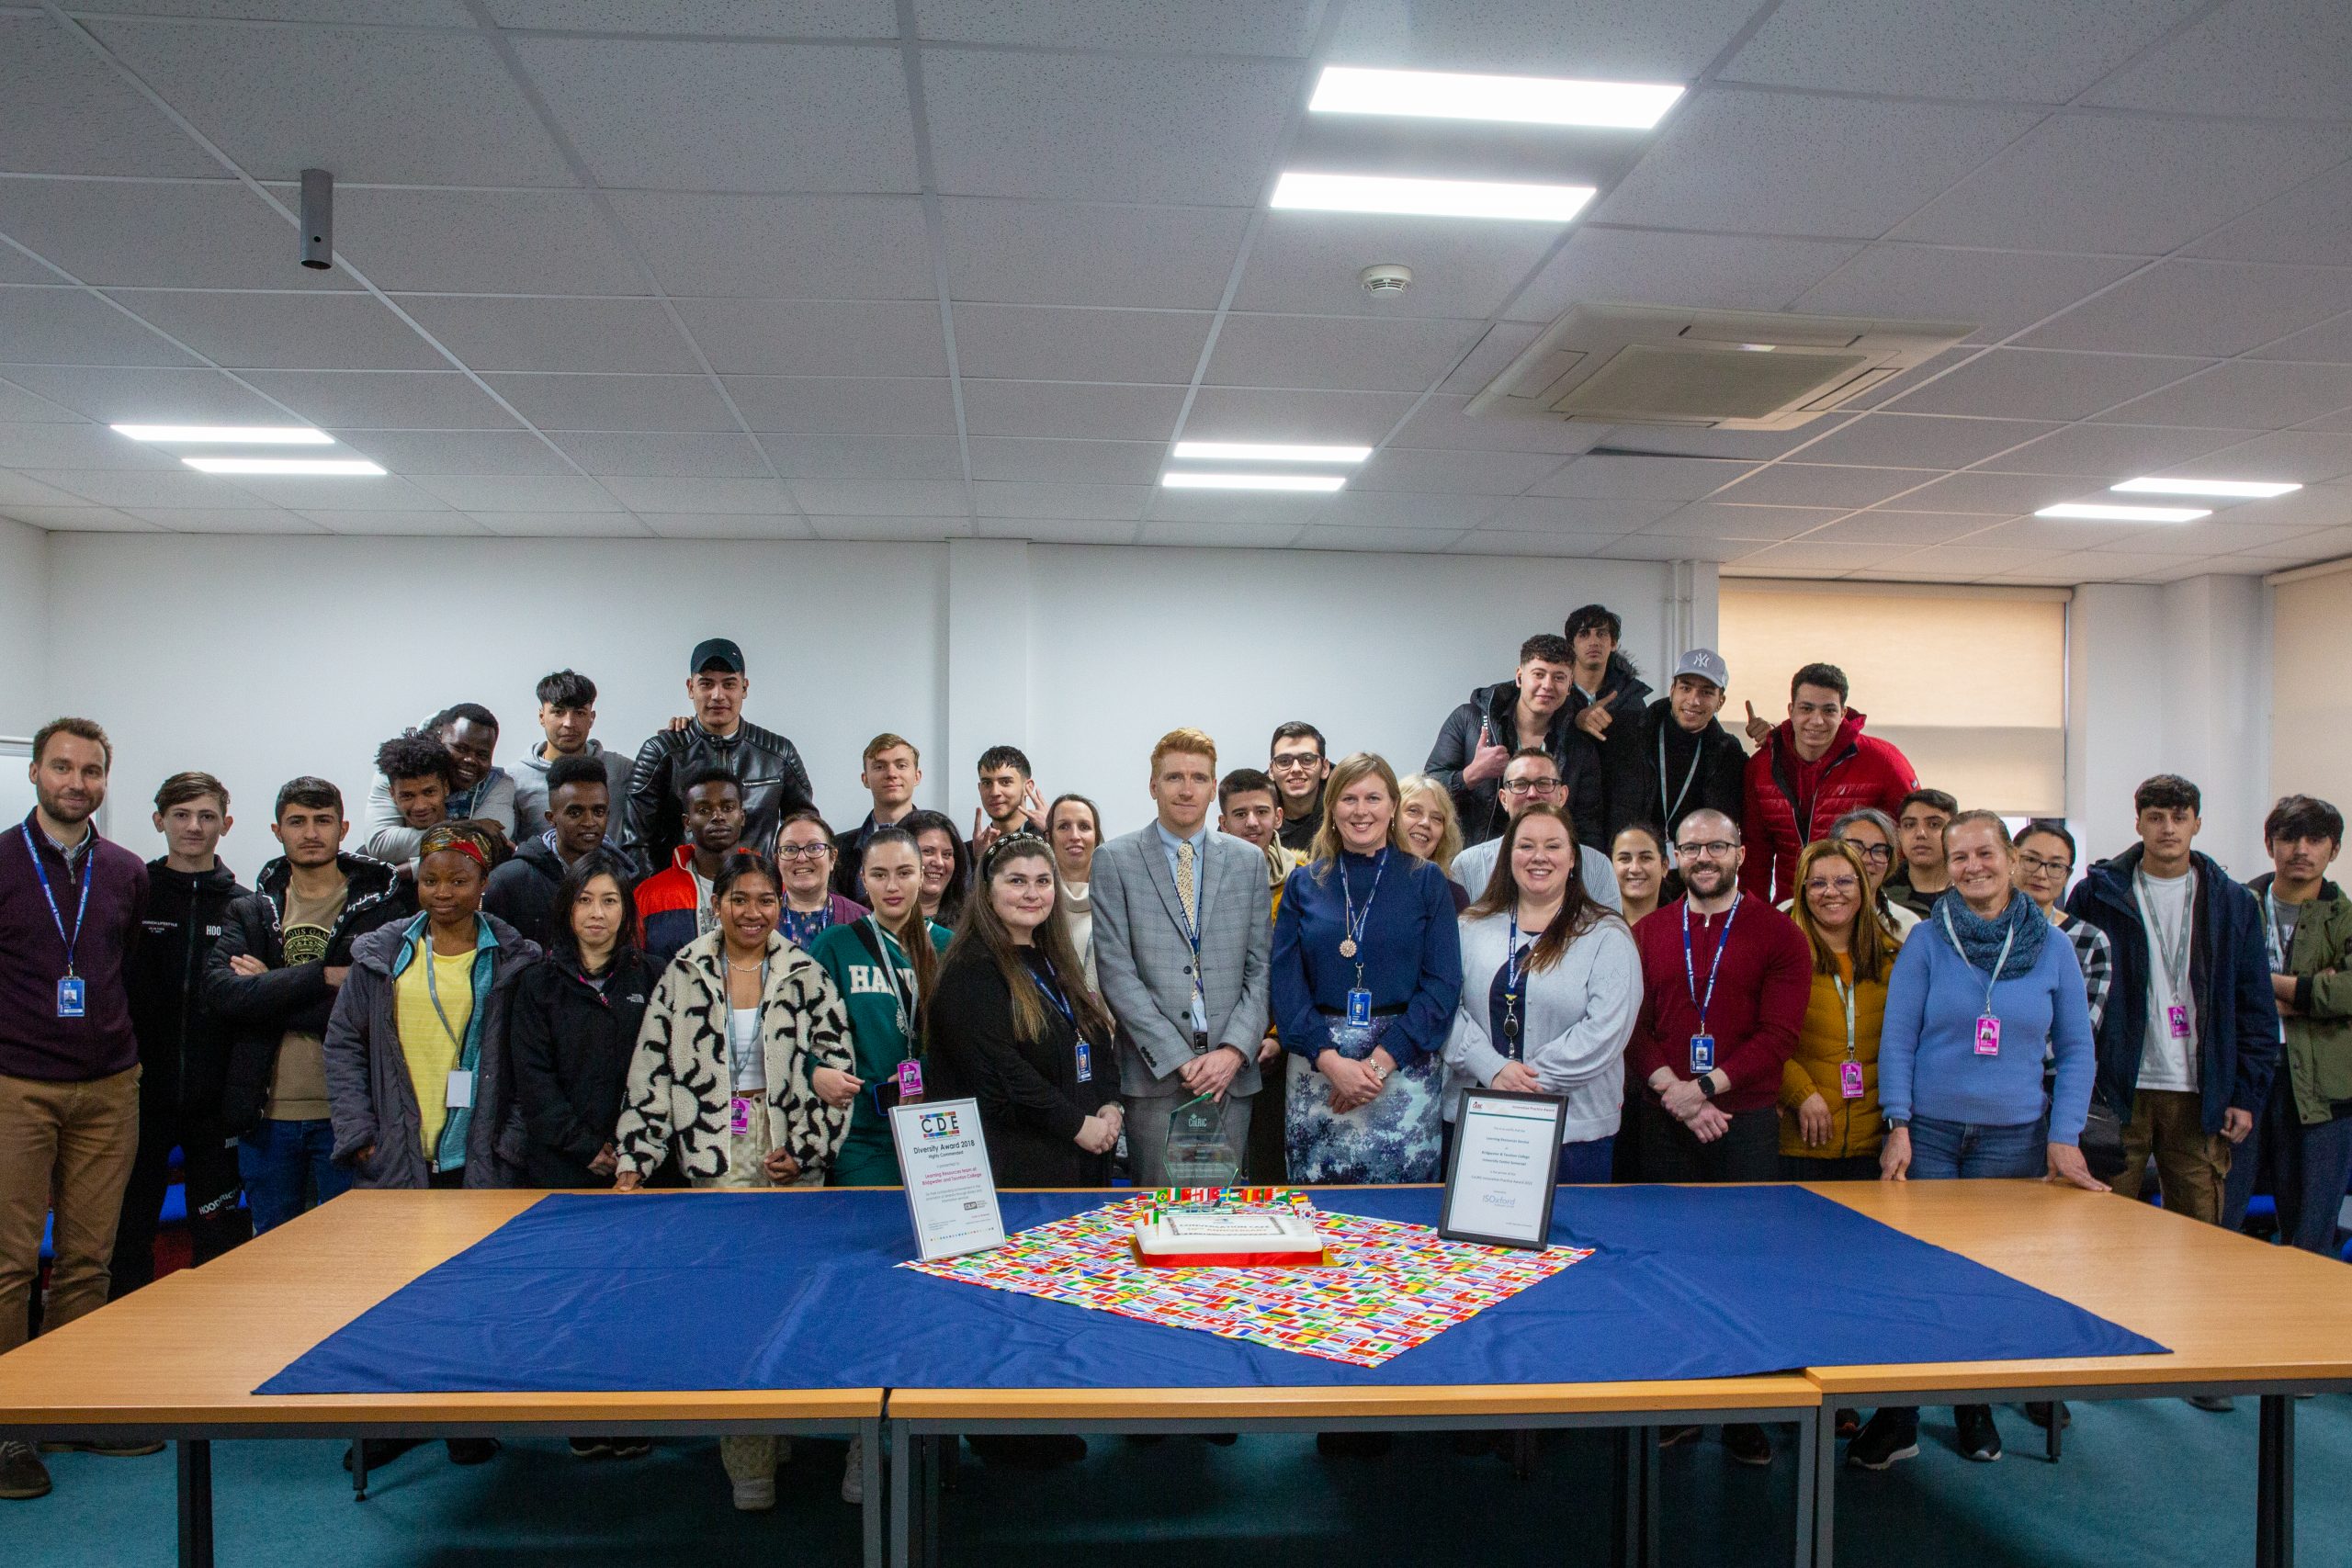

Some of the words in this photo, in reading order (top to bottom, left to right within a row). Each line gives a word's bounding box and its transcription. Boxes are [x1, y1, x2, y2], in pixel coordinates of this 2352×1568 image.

[29, 847, 39, 863] College
[1725, 909, 1736, 928] Bridgwater
[206, 925, 221, 936] HOO
[1704, 983, 1713, 1007] Bridgwater
[914, 1145, 939, 1154] Diversity
[940, 1143, 960, 1151] Award
[961, 1139, 975, 1148] 2018
